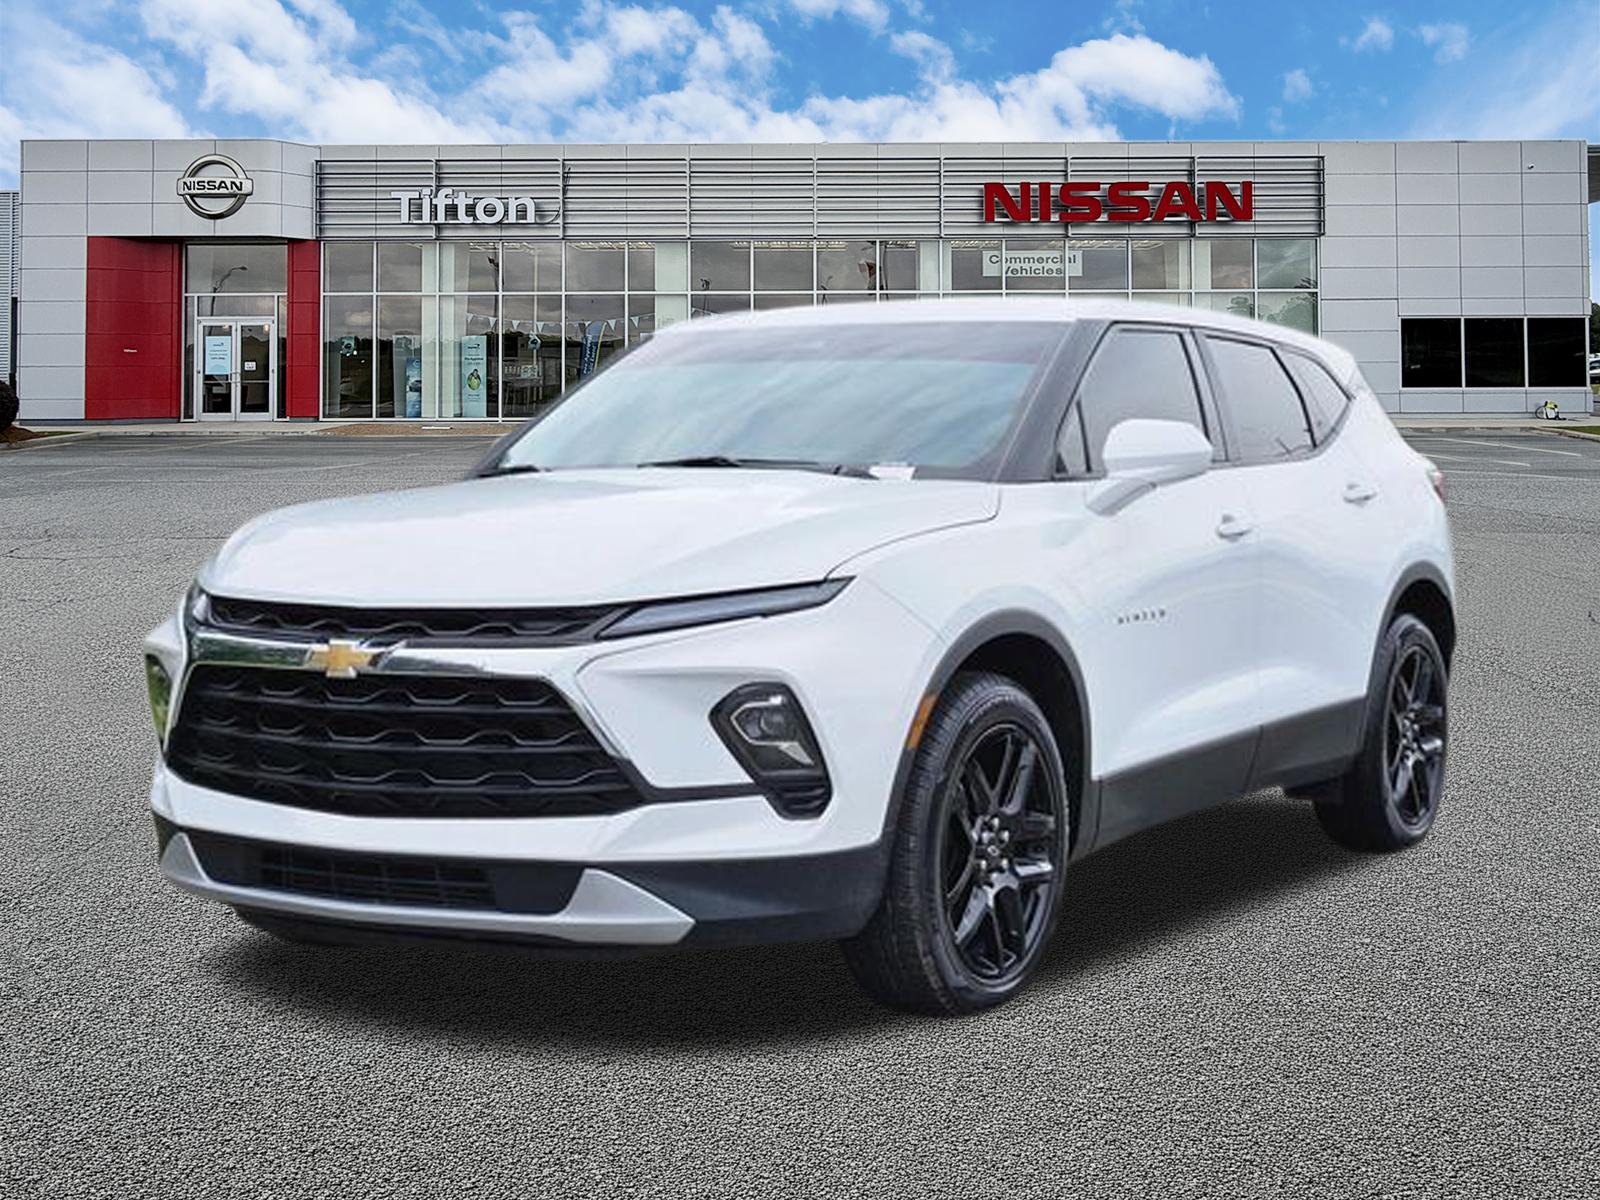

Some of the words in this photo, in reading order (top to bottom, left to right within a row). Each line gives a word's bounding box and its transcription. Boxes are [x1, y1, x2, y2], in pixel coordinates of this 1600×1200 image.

[182, 180, 243, 191] NISSAN
[983, 181, 1253, 222] NISSAN
[391, 187, 536, 224] Tifton
